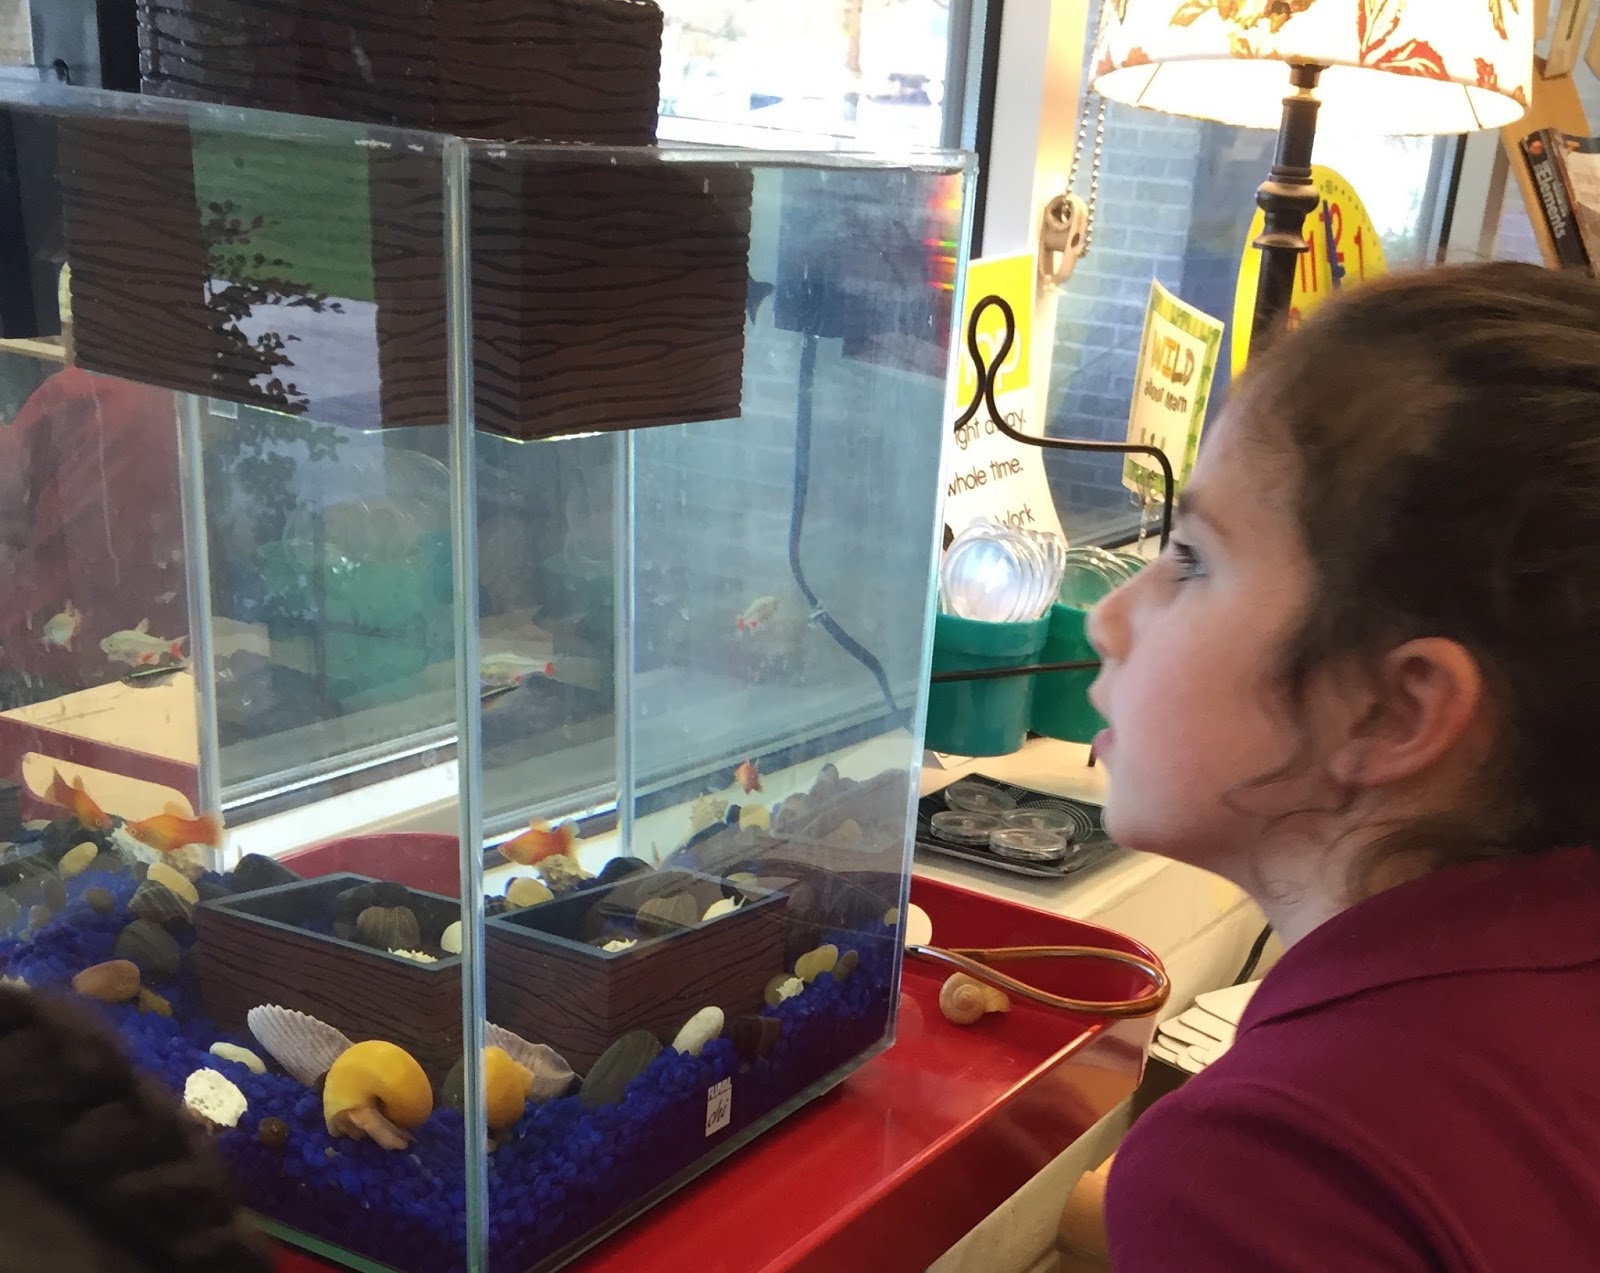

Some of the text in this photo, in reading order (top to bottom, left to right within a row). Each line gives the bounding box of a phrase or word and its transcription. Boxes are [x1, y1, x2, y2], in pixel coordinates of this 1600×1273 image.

[1536, 167, 1567, 239] Elements
[1151, 334, 1195, 387] WILD
[984, 408, 1027, 434] aay.
[947, 458, 1024, 497] whole time.
